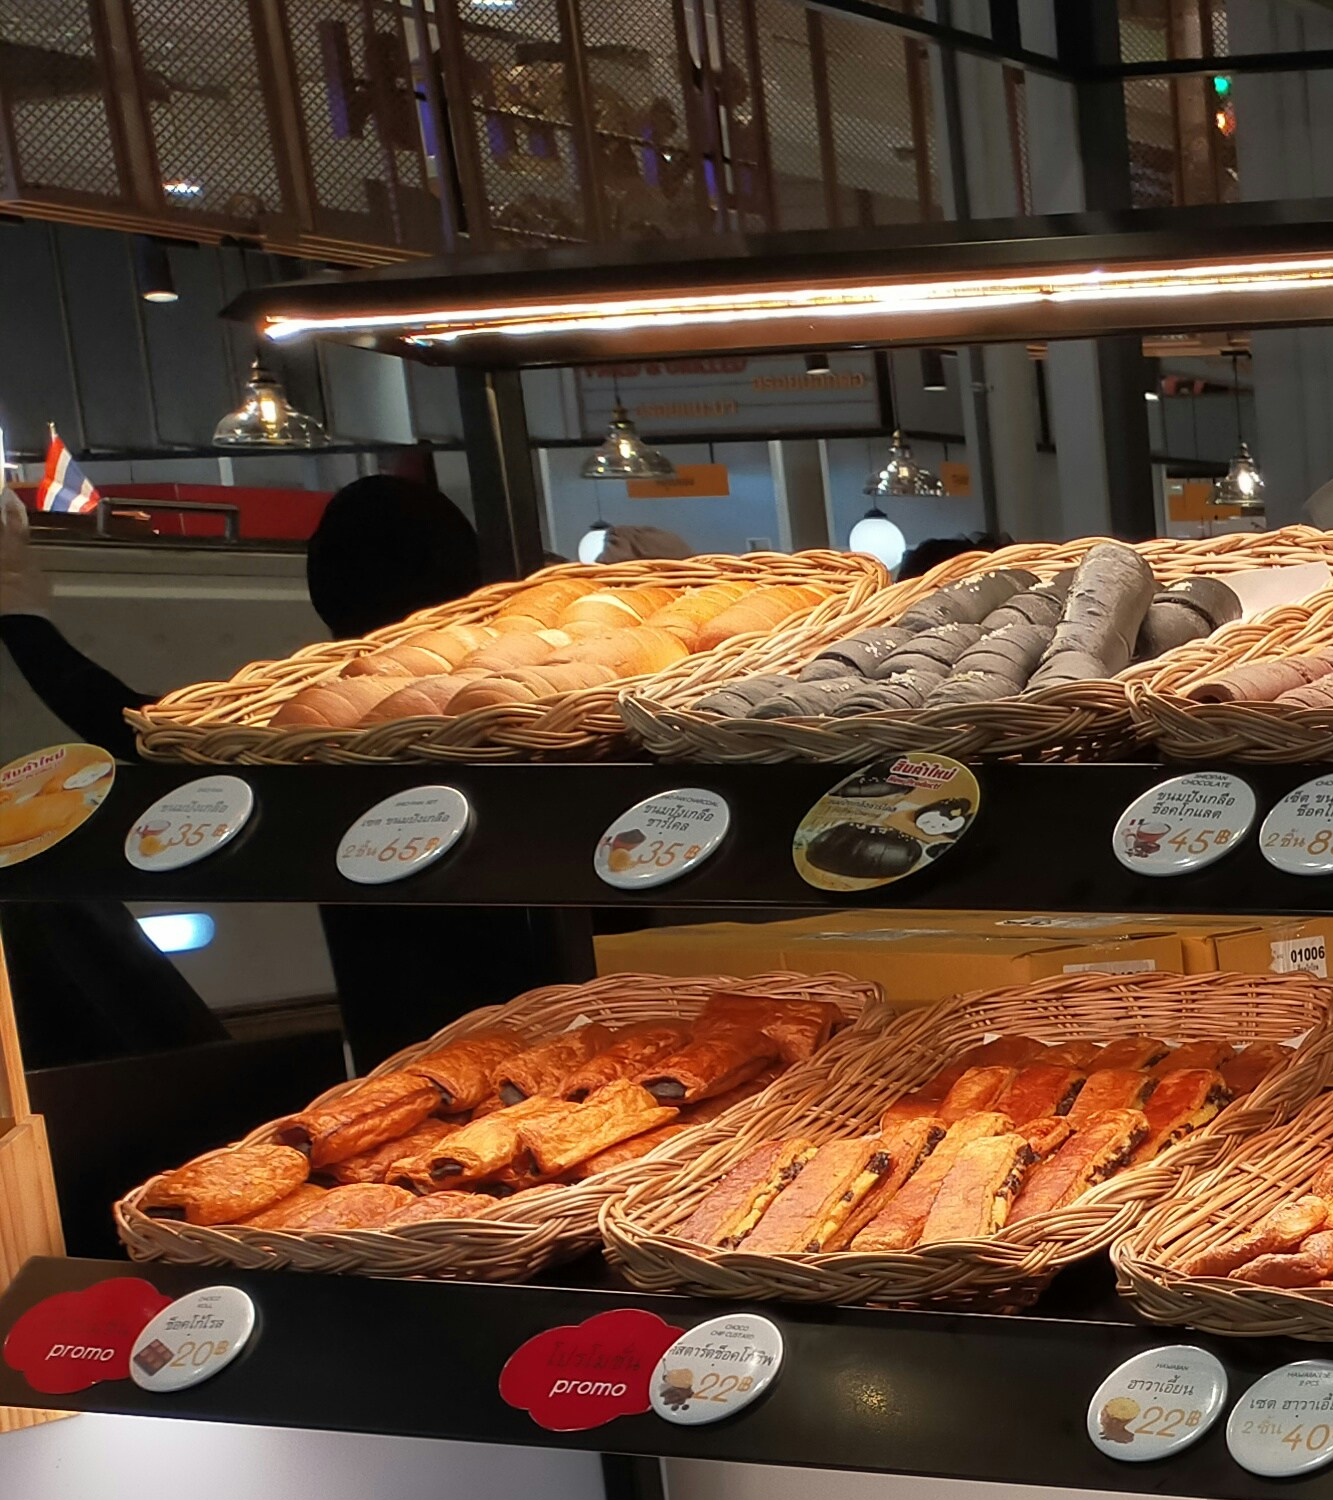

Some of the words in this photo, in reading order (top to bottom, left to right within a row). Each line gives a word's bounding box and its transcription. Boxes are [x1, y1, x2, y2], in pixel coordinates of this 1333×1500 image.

[1265, 832, 1281, 848] 2
[1291, 946, 1325, 963] 01006
[44, 1342, 115, 1362] promo
[549, 1377, 628, 1398] promo
[1241, 1420, 1254, 1434] 2
